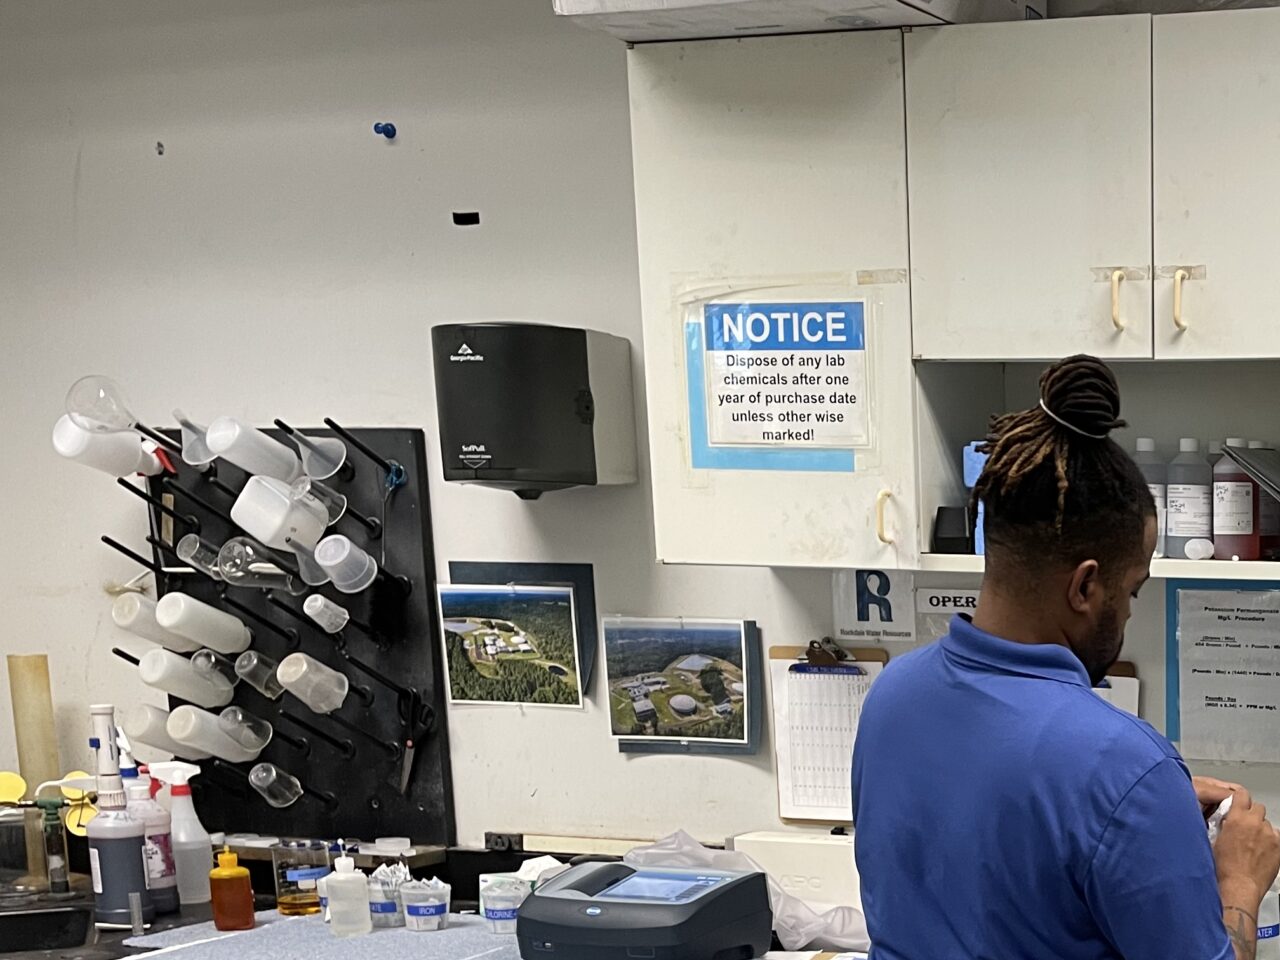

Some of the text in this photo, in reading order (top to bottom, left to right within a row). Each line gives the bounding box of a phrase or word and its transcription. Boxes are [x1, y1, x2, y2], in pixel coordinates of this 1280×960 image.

[722, 311, 847, 343] NOTICE
[726, 354, 846, 370] Dispose of any lab
[723, 373, 850, 385] chemicals after one
[717, 391, 857, 407] year of purchase date
[731, 410, 845, 423] unless other wise
[762, 428, 815, 442] marked!
[418, 906, 436, 915] IRON
[1257, 927, 1273, 938] ATER
